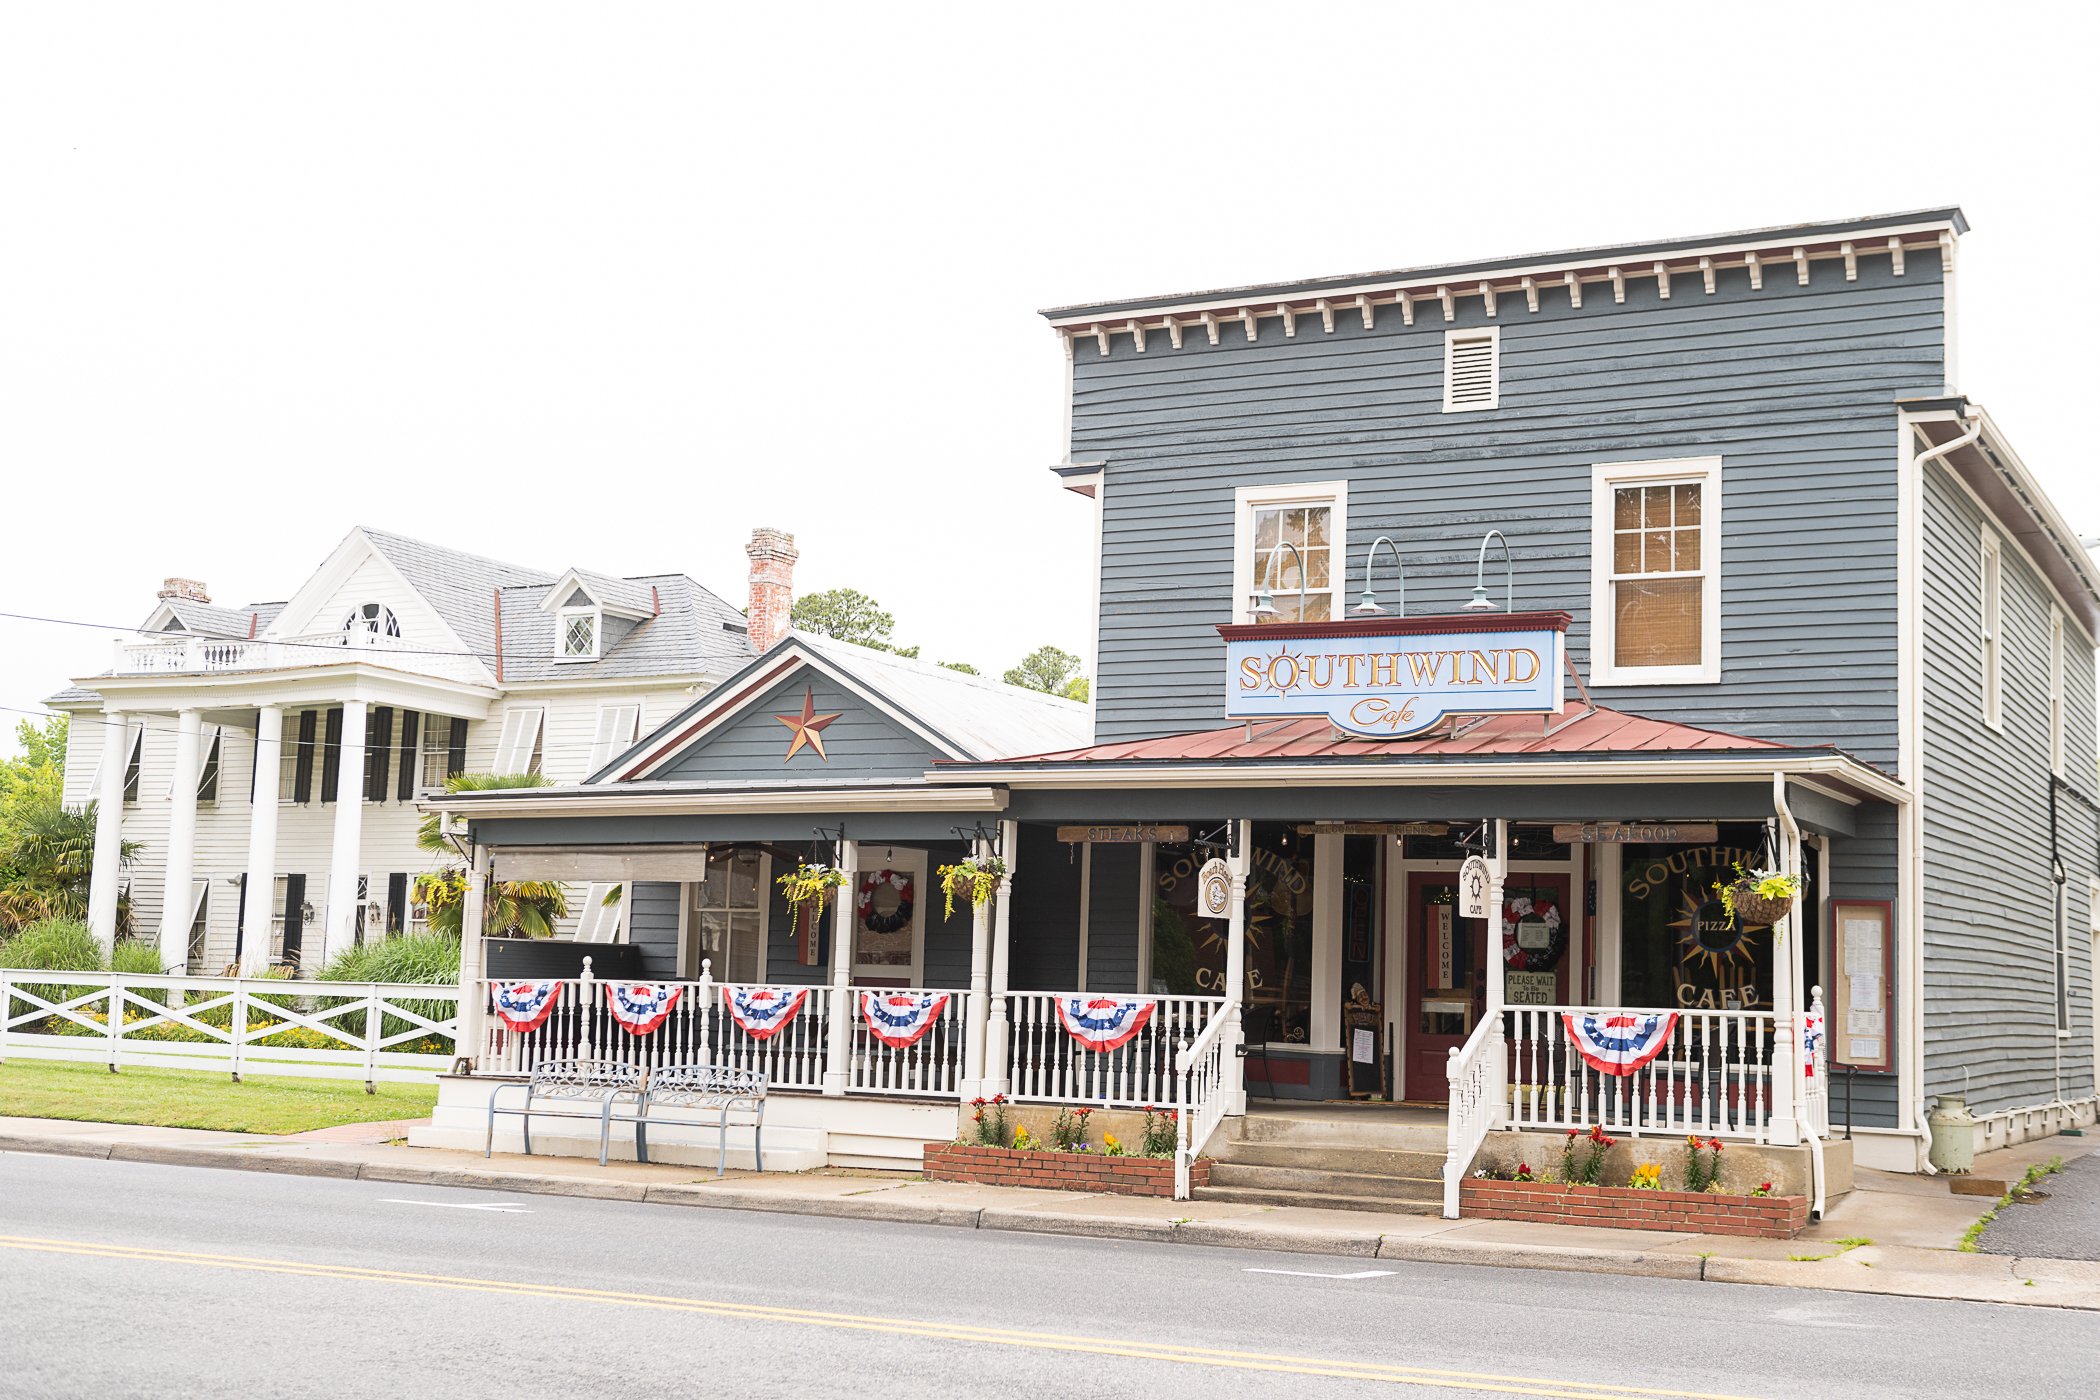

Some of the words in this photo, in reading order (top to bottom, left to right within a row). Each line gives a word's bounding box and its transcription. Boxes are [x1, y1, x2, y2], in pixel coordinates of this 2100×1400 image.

[1239, 647, 1541, 691] SOUTHWIND
[1348, 697, 1420, 731] Cafe
[1087, 827, 1158, 842] STEAKS
[1580, 825, 1678, 842] SEAFOOD
[1462, 858, 1491, 884] SOUTHWIND
[1469, 904, 1483, 915] CAFE
[1697, 921, 1737, 931] PIZZA
[1441, 912, 1450, 979] WELCOME
[1195, 967, 1263, 992] CAE
[1508, 975, 1535, 985] PLEASE
[1536, 976, 1554, 986] WAIT
[1513, 991, 1548, 1004] SEATED
[1677, 983, 1759, 1010] CAFE
